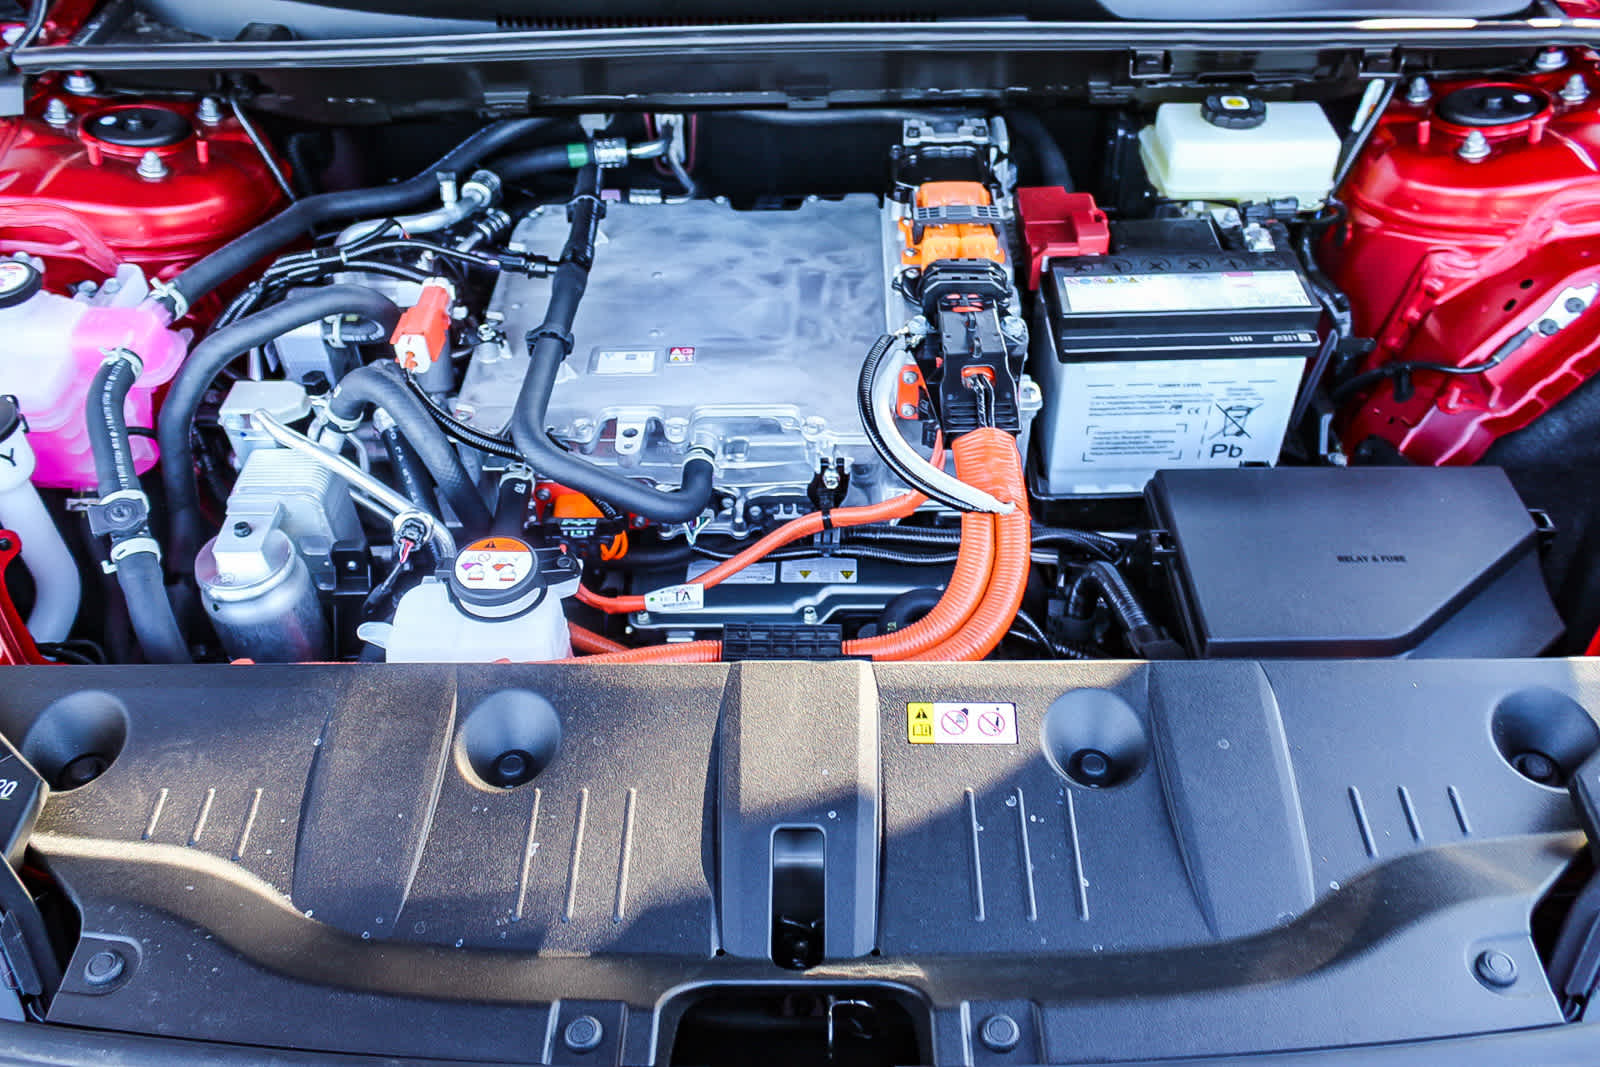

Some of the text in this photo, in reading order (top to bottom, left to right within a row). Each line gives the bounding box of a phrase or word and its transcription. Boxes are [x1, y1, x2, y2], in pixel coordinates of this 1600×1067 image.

[1210, 443, 1243, 459] Pb
[1336, 555, 1369, 563] RELAY
[1380, 555, 1407, 563] FUSE
